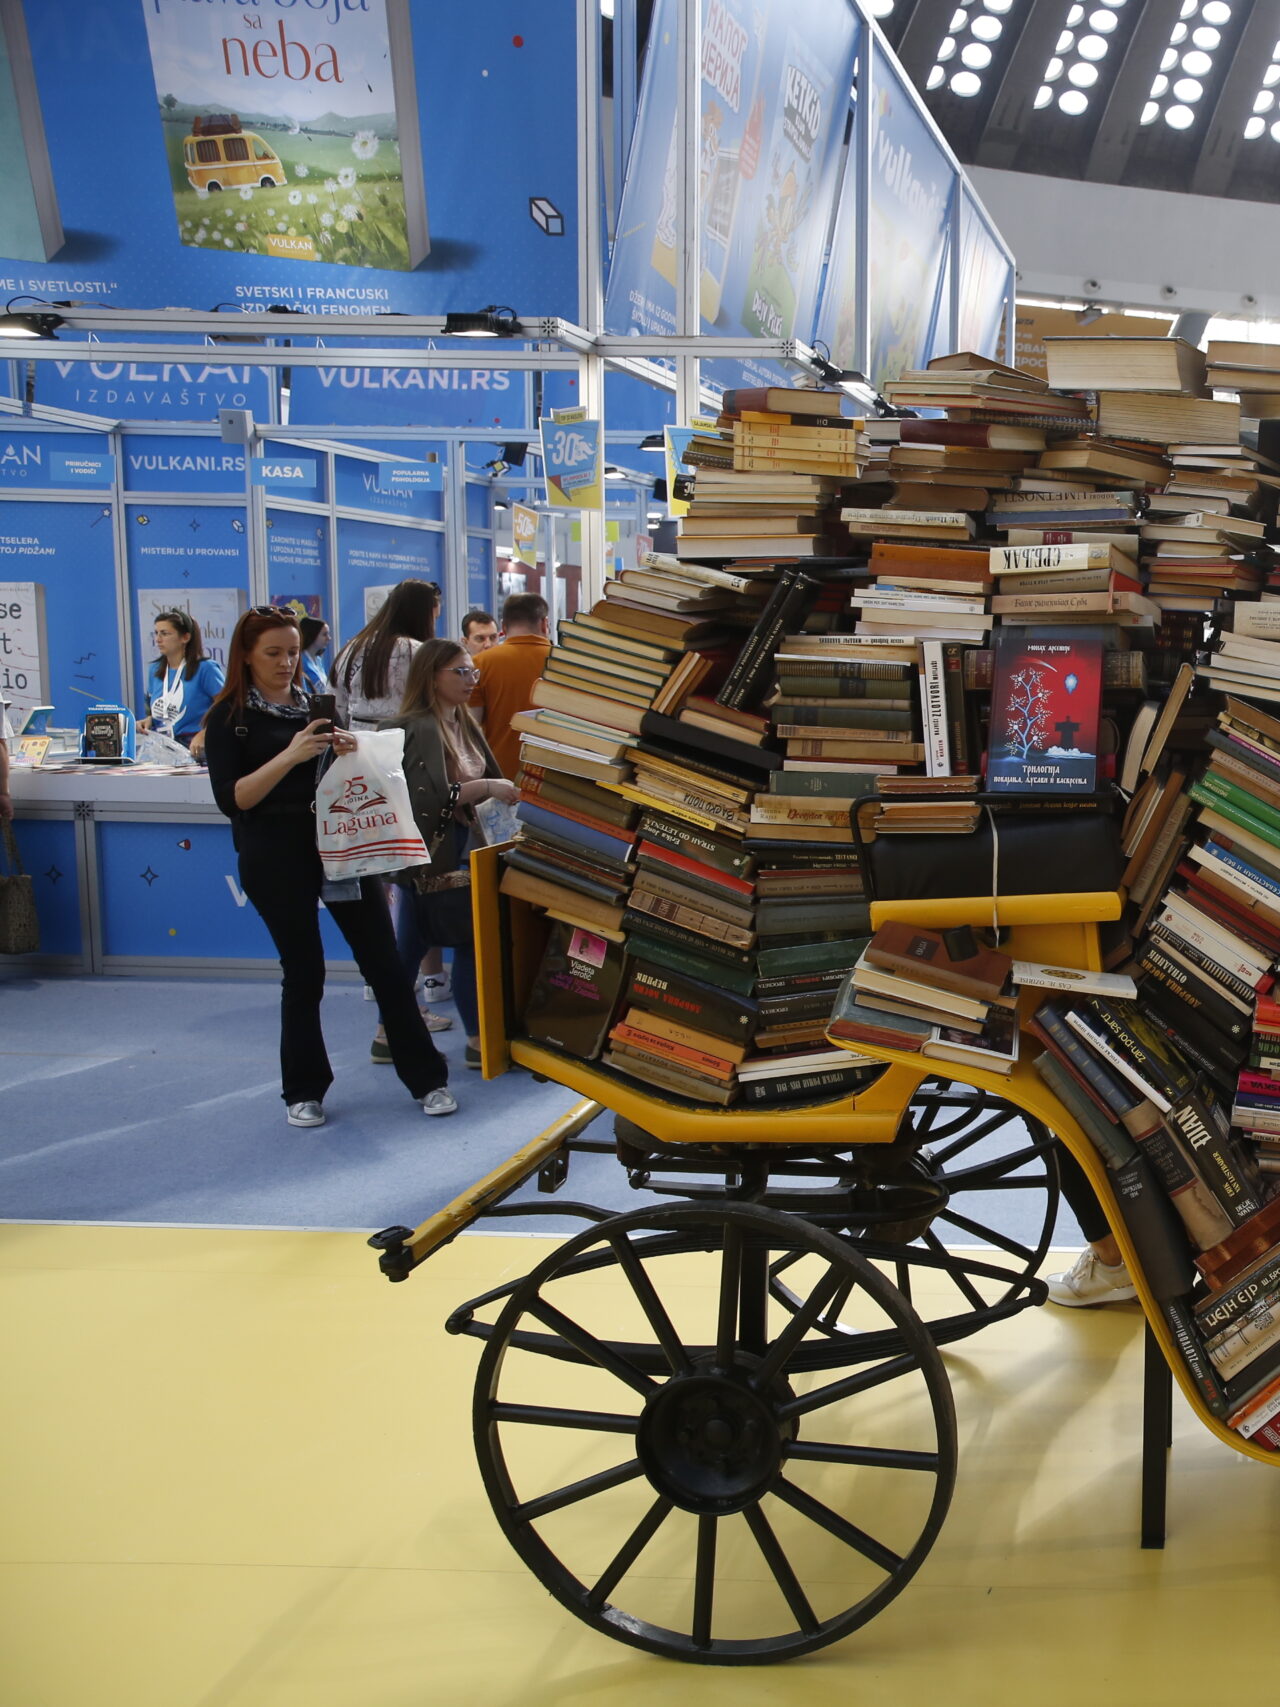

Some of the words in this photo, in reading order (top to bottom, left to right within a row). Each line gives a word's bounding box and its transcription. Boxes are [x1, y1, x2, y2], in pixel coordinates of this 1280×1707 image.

[243, 13, 263, 30] sa
[222, 20, 344, 84] neba
[269, 237, 313, 251] VULKAN
[20, 280, 25, 292] I
[235, 286, 294, 299] SVETSKI
[298, 288, 303, 299] I
[306, 287, 389, 301] FRANCUSKI
[75, 389, 248, 406] IZDAVAŠTVO
[130, 455, 246, 471] VULKANI.RS
[261, 464, 304, 479] KASA
[141, 547, 185, 556] MISTERIJE
[187, 548, 193, 556] U
[195, 548, 239, 557] PROVANSI
[929, 680, 941, 718] ZLOTVORI
[1022, 764, 1060, 777] ТРИЛОГИЈА
[681, 792, 706, 809] ПОПА
[322, 810, 399, 837] Laguna
[643, 817, 678, 835] LETENJA
[678, 831, 690, 840] OD
[690, 837, 716, 852] STRAH
[568, 966, 592, 981] Jerotić
[569, 959, 595, 975] Vladeta
[1146, 948, 1188, 984] ОТПАДНИК
[1099, 1010, 1121, 1034] sartr
[1175, 1327, 1198, 1363] ZLOTVORI
